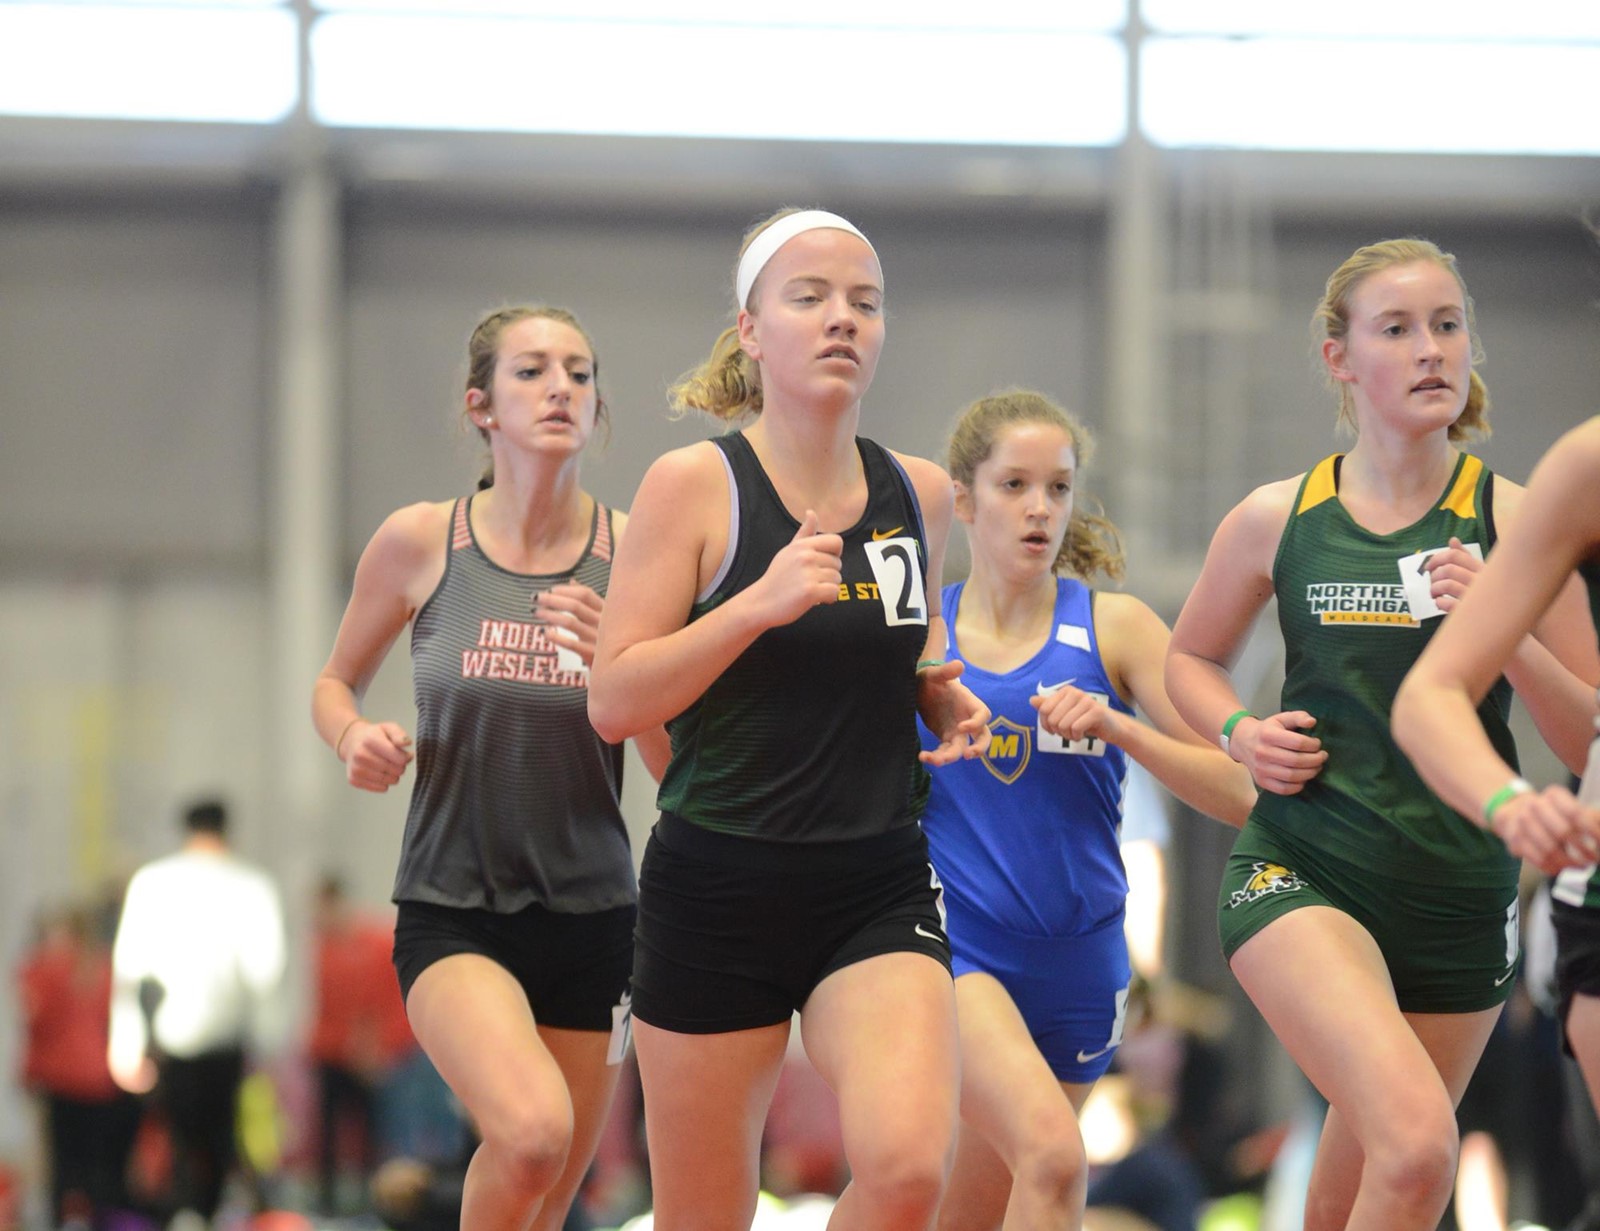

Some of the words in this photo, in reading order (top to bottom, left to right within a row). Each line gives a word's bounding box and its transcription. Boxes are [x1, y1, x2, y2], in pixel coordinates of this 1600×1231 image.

[880, 544, 922, 620] 2
[1309, 585, 1407, 599] NORTHE
[478, 619, 558, 652] INDIA
[988, 735, 1019, 758] M
